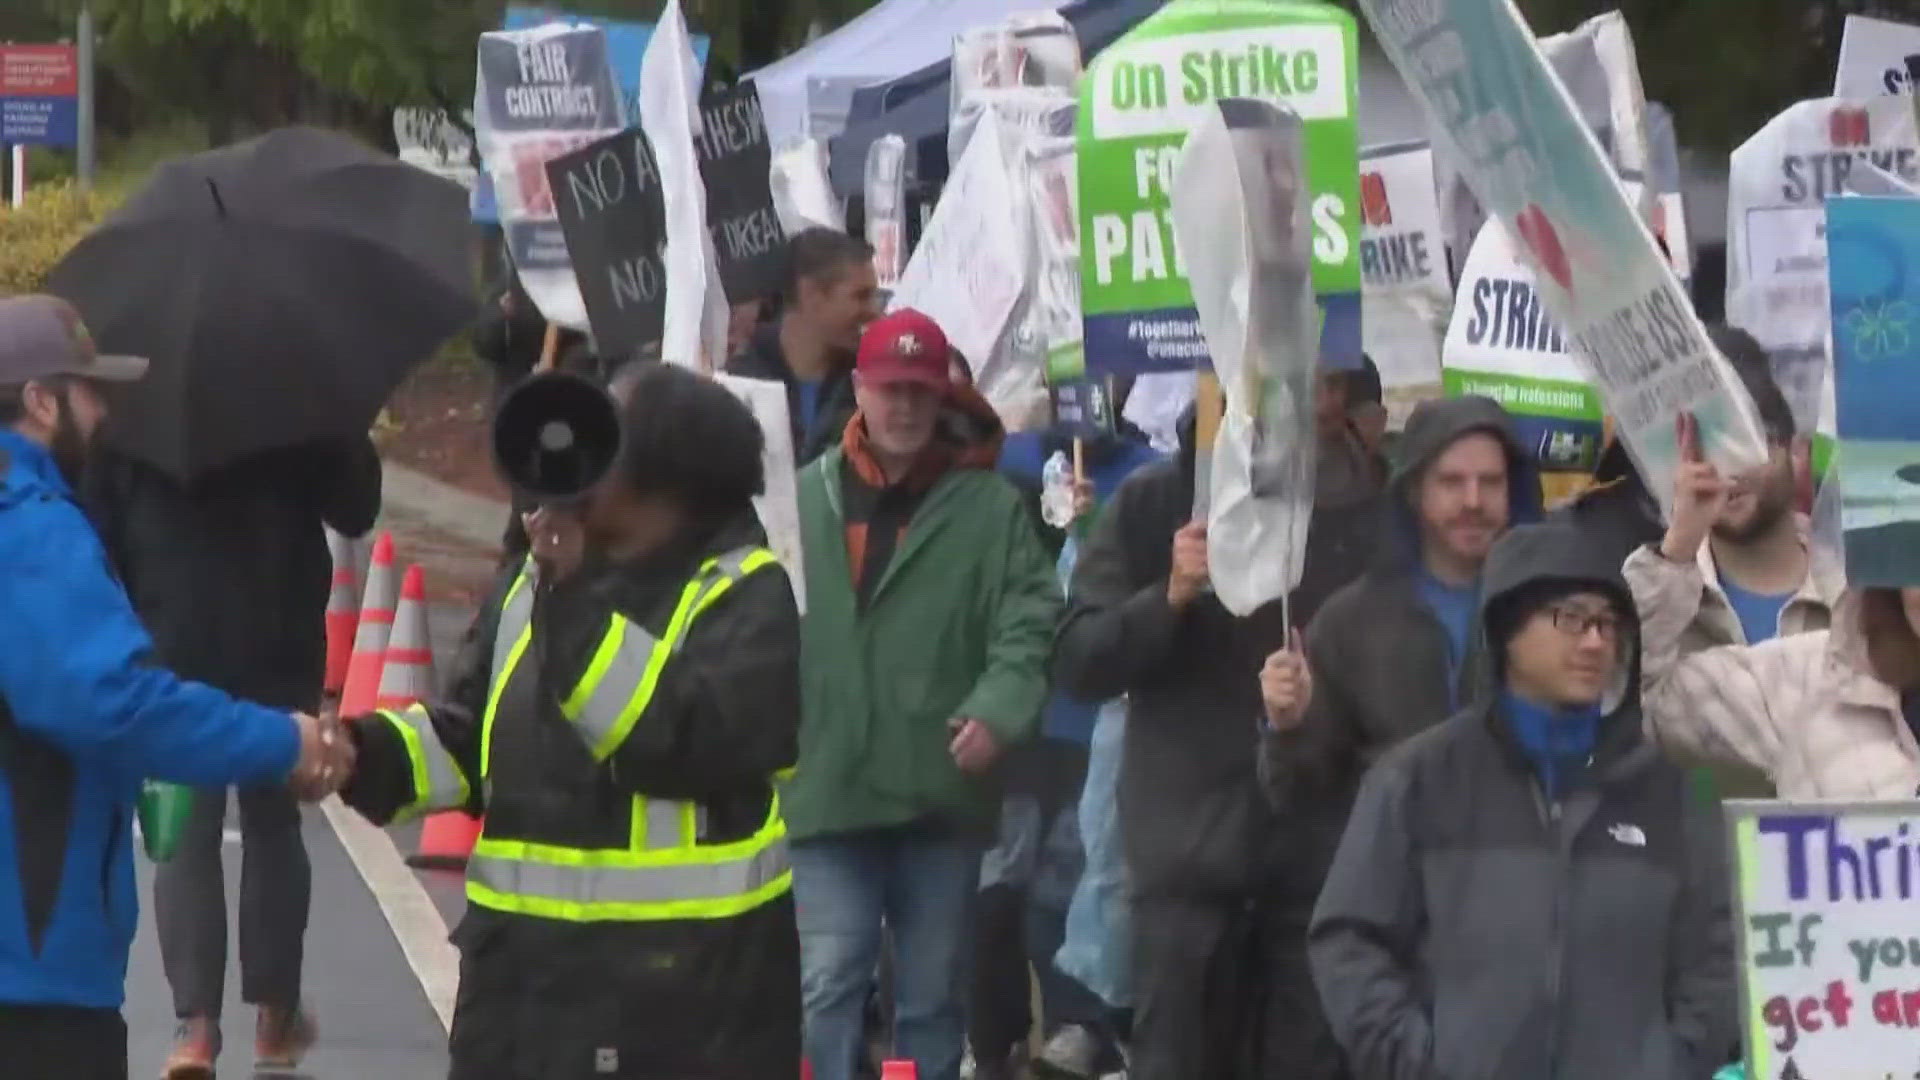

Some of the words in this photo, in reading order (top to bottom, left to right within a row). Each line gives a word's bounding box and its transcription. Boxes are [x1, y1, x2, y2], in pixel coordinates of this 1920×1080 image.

[517, 41, 569, 83] FAIR
[1112, 60, 1167, 110] On
[1181, 43, 1319, 106] Strike
[505, 85, 597, 118] CONTRACT
[567, 150, 625, 221] NO
[1136, 146, 1186, 198] FO
[609, 256, 658, 309] NO
[1360, 231, 1432, 284] RIKE
[1466, 276, 1568, 354] STRI
[1759, 813, 1920, 903] Thri
[1750, 912, 1823, 967] If
[1762, 980, 1853, 1053] get
